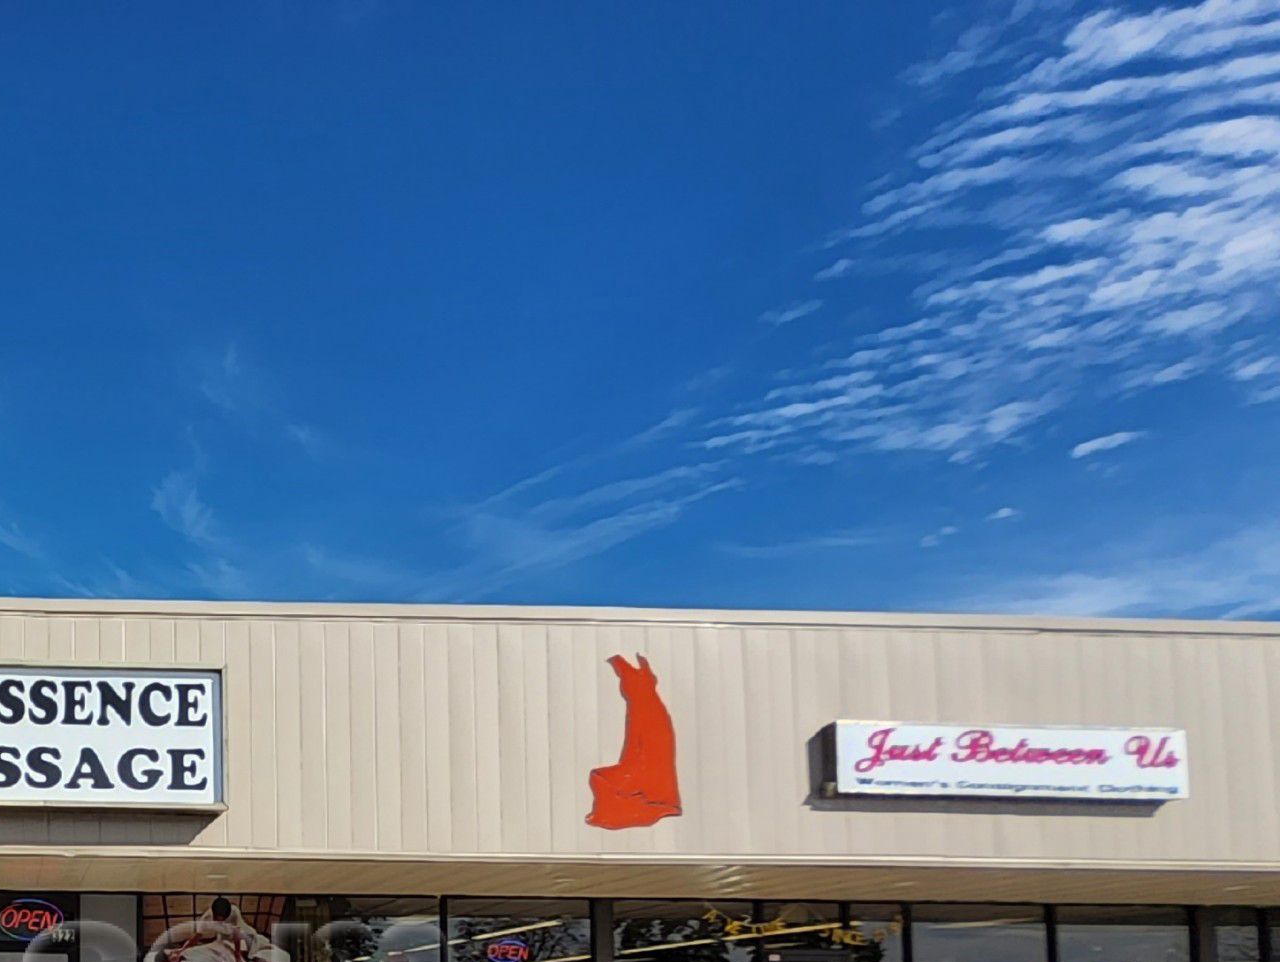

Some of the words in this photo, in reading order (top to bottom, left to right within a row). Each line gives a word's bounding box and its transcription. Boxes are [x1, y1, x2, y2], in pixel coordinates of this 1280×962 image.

[854, 728, 944, 772] Just
[951, 730, 1113, 765] Between
[1124, 735, 1181, 768] Us
[0, 907, 59, 932] OPEN
[487, 943, 529, 961] OPEN
